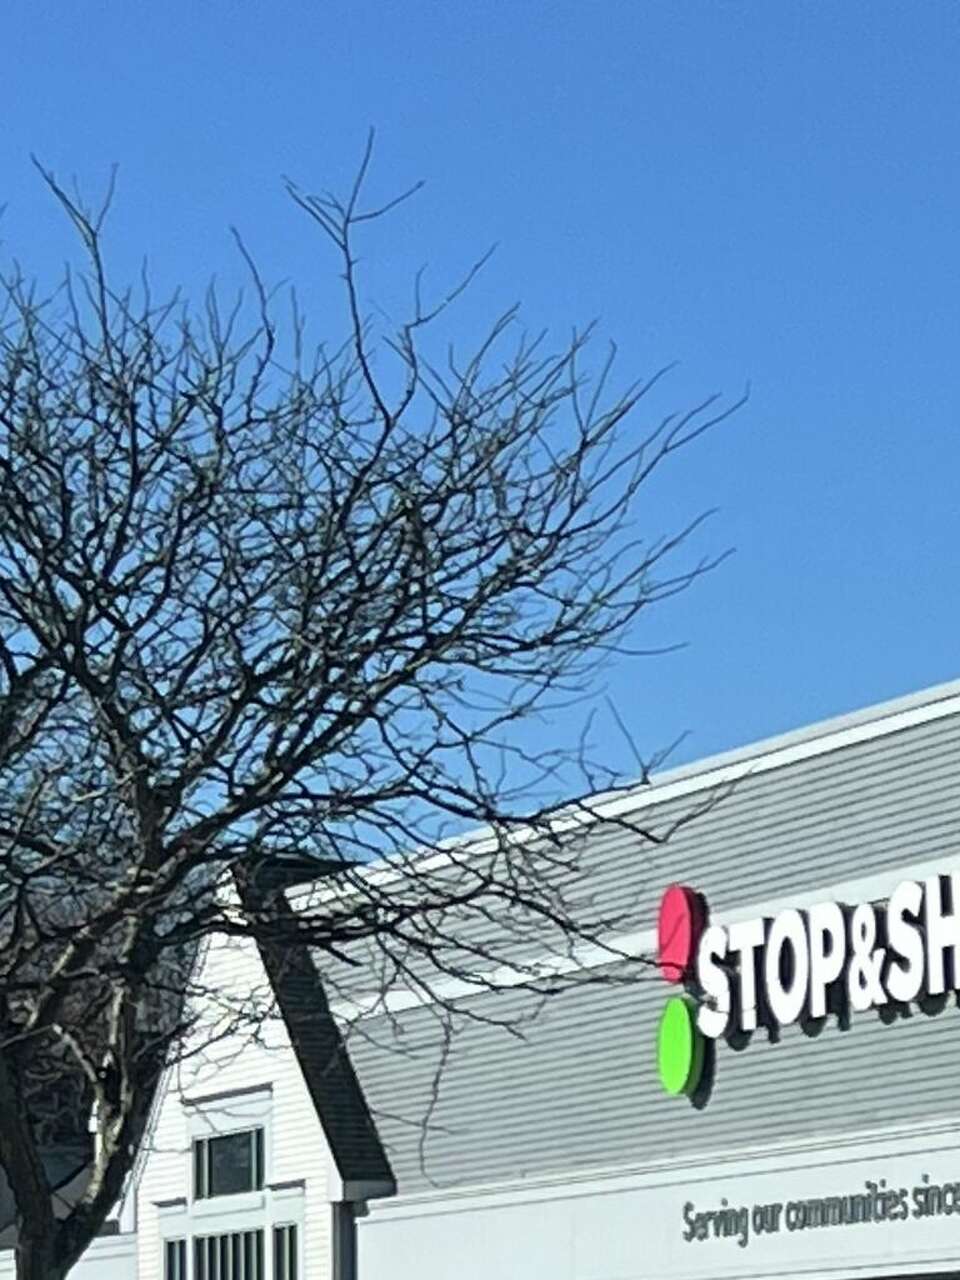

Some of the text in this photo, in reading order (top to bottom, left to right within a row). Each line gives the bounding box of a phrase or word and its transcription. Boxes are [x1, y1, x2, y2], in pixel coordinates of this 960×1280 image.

[682, 1197, 749, 1249] Serving
[752, 1202, 783, 1236] our
[785, 1178, 909, 1232] communities
